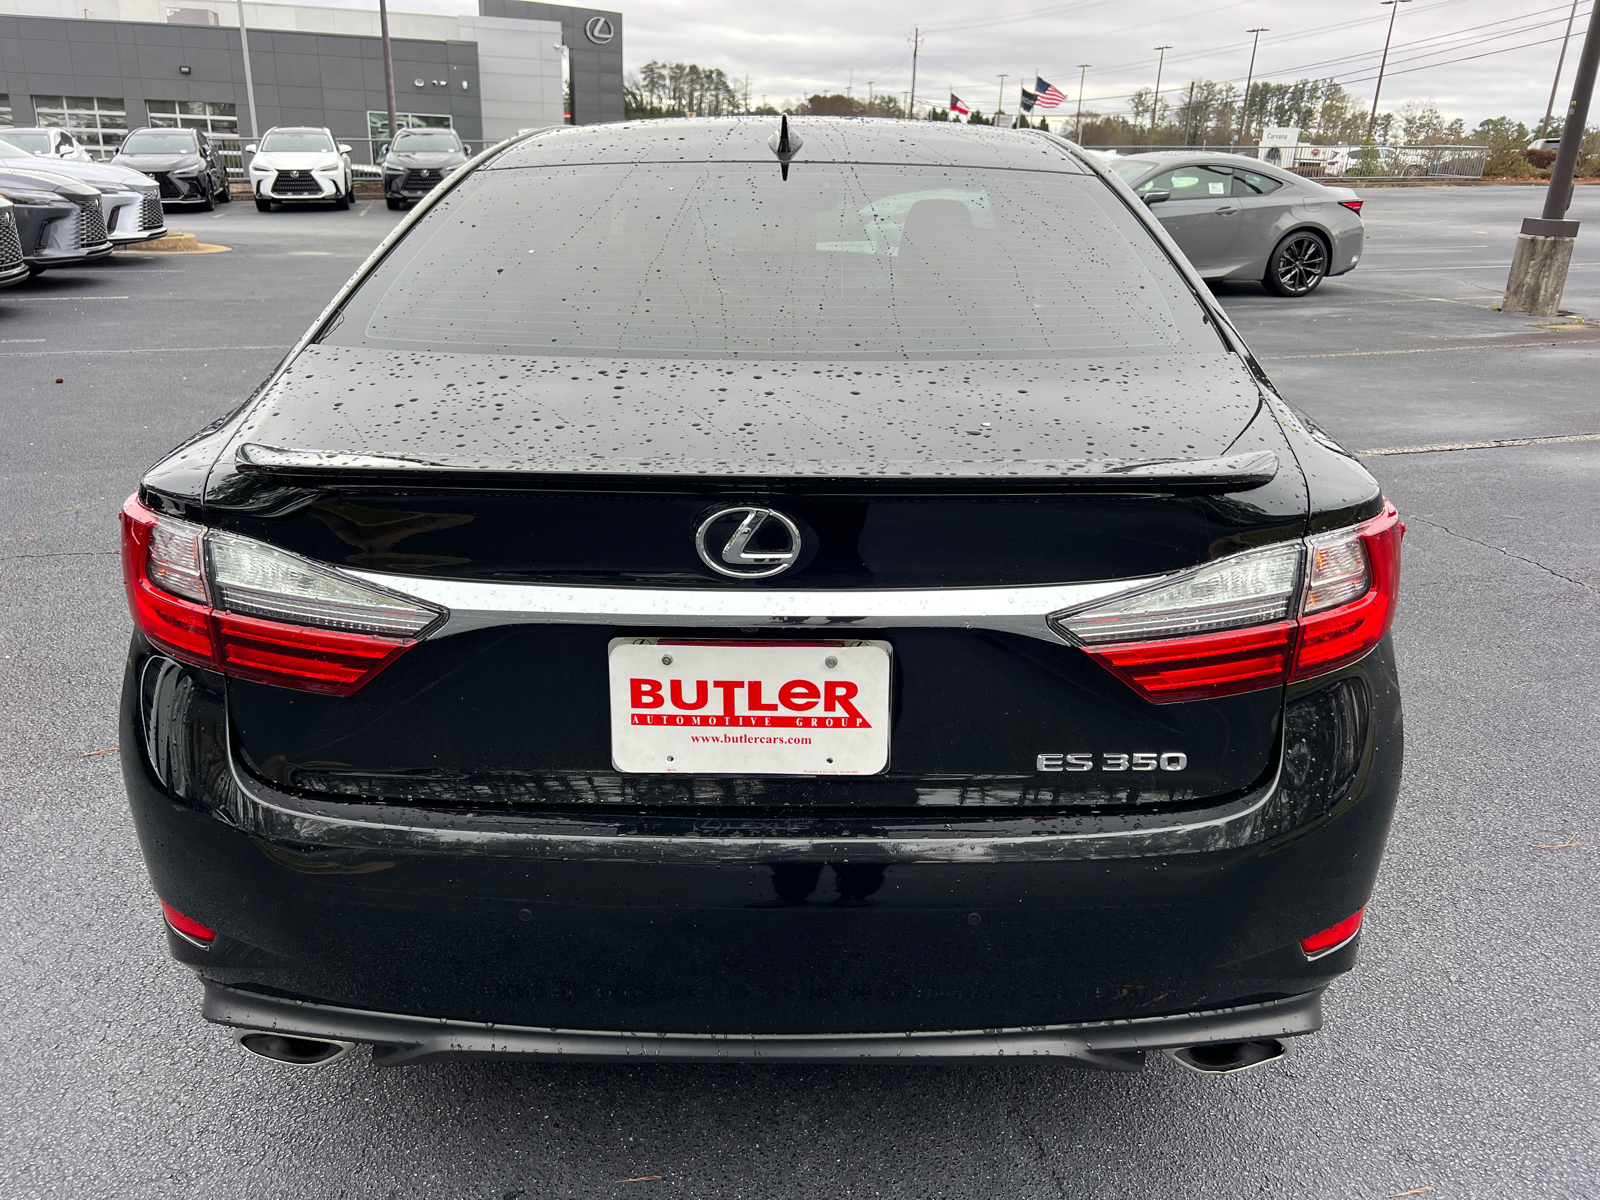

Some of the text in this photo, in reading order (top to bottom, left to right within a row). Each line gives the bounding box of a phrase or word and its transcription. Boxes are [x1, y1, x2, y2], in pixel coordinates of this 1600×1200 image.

[1267, 132, 1288, 140] Carvana
[632, 715, 863, 728] AUTOMOTIVE GROUP
[691, 733, 812, 745] www.butlercars.com
[1036, 752, 1188, 772] ES 350
